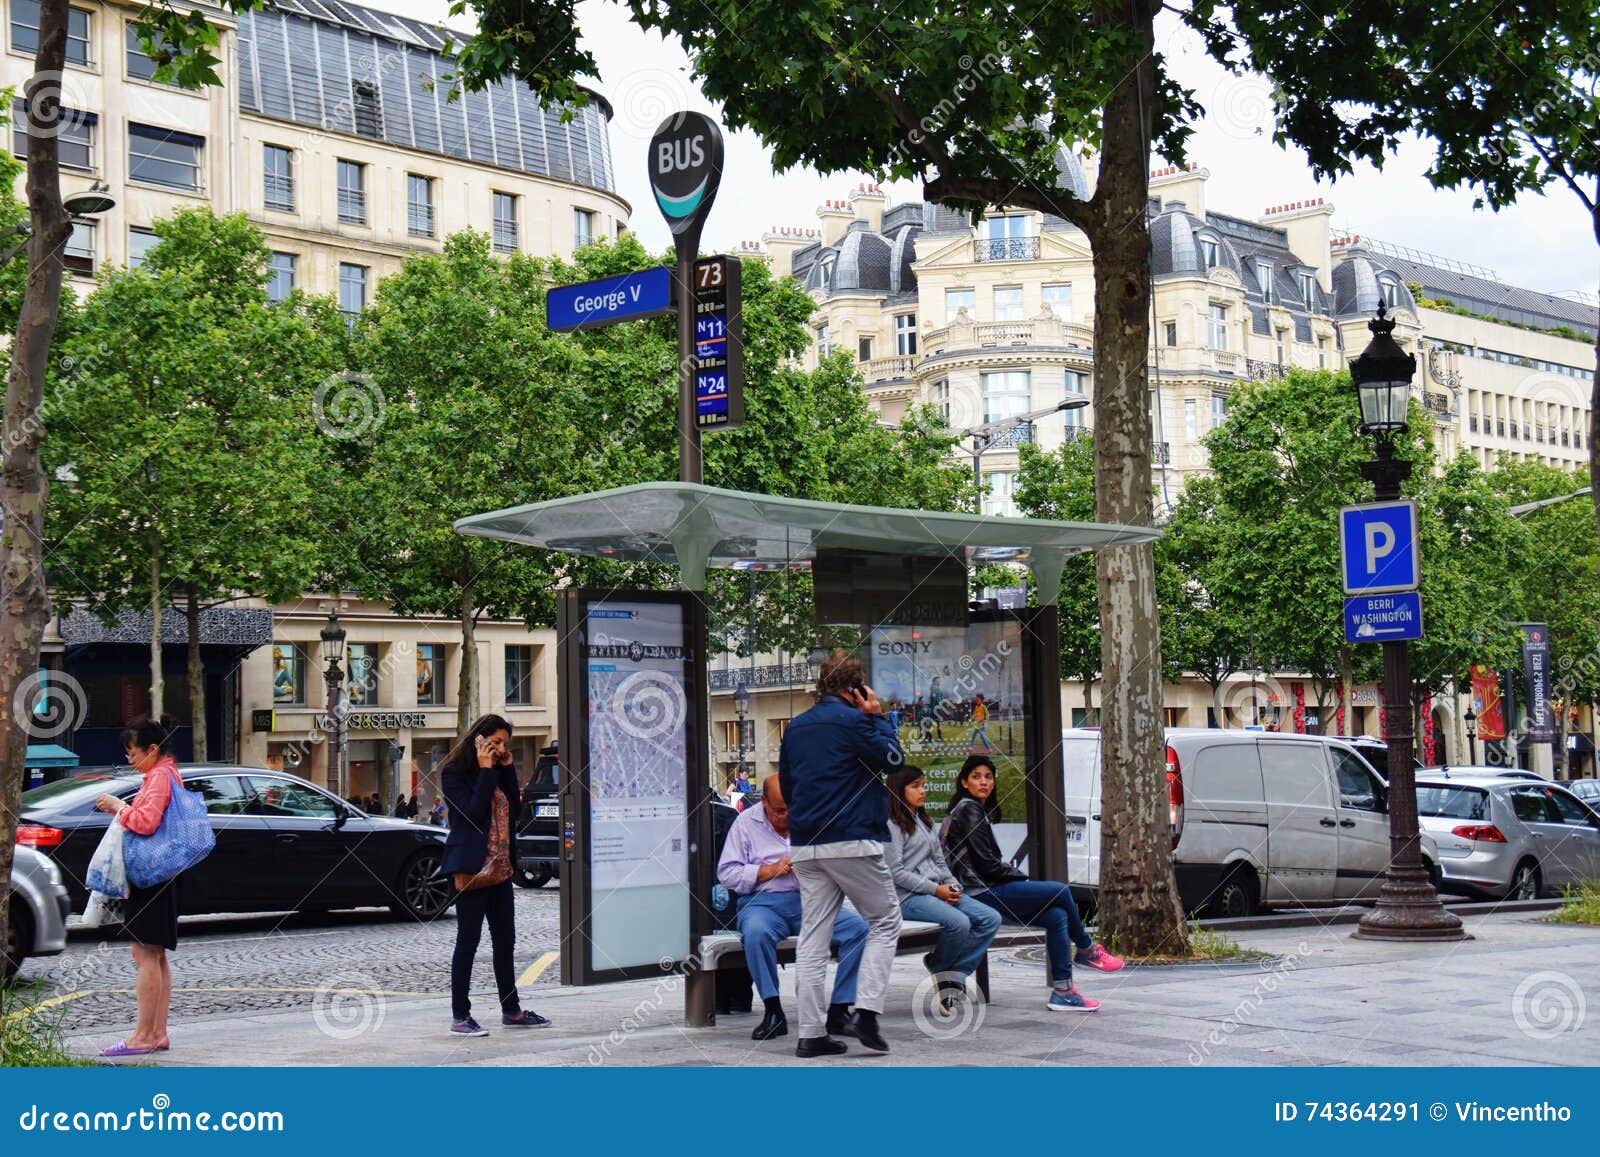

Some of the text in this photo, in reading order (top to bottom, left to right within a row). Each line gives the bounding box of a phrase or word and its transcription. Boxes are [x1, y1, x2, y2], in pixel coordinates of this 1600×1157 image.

[659, 134, 705, 174] BUS
[699, 262, 721, 286] 73
[574, 284, 641, 313] George V
[1364, 521, 1396, 574] P
[1368, 598, 1395, 610] BERRI
[1352, 610, 1412, 624] WASHINGTON
[878, 641, 932, 656] SONY
[1351, 690, 1377, 701] ORGAN
